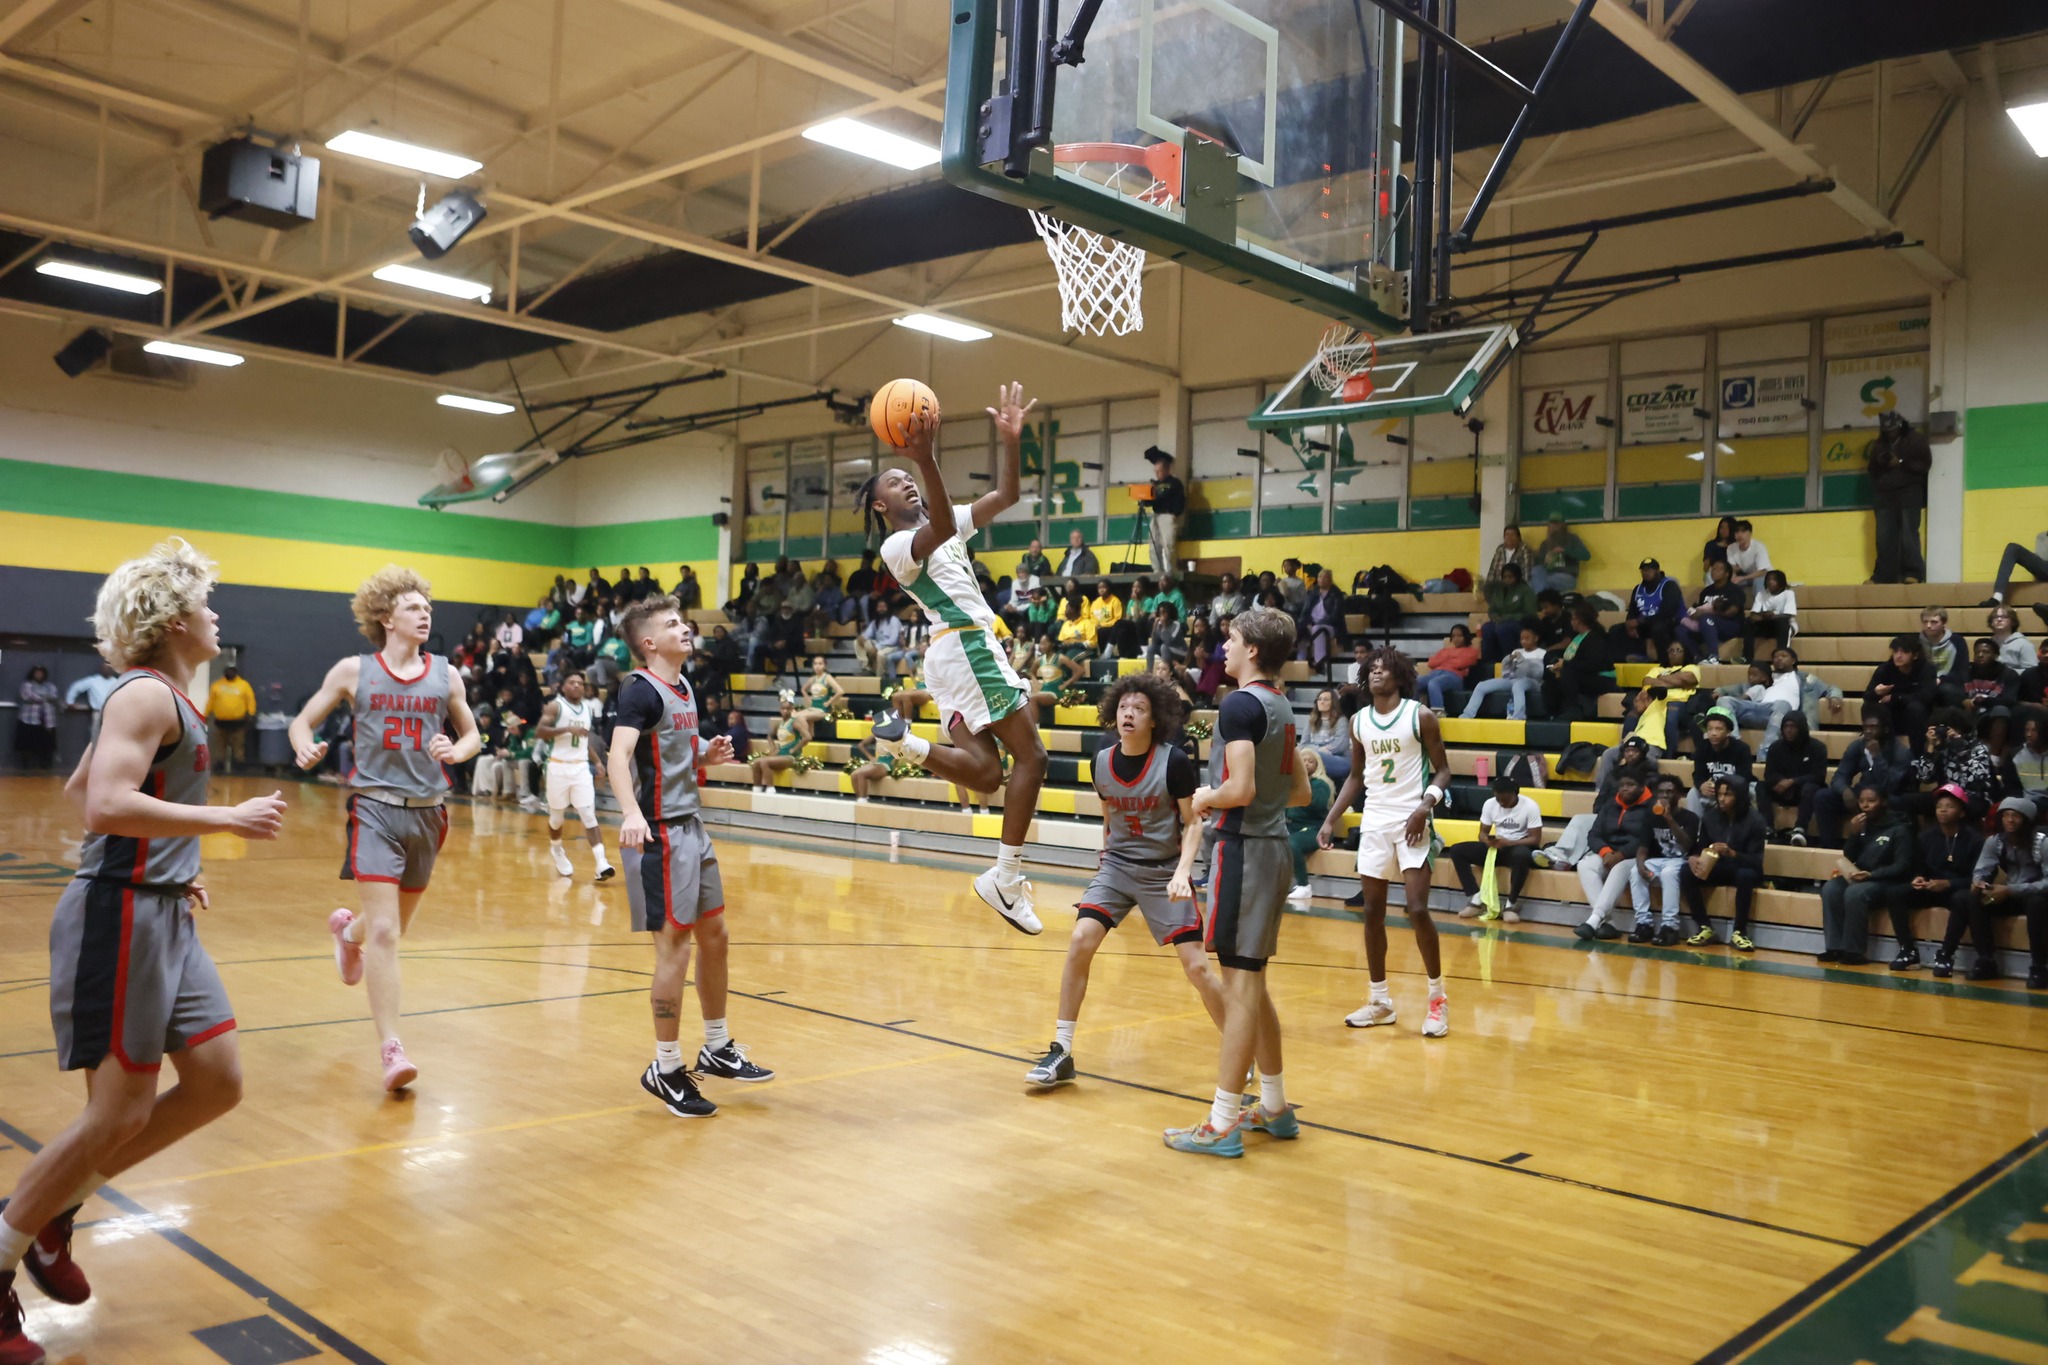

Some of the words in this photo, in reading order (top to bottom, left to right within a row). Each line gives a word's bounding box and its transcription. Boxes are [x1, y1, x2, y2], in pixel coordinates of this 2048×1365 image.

[1626, 387, 1699, 407] COZART
[1533, 389, 1596, 436] F&M
[1559, 421, 1586, 432] BANK
[370, 693, 438, 714] SPARTANS
[383, 716, 423, 751] 24
[1279, 723, 1295, 775] 11
[1371, 738, 1402, 755] CAVS
[1381, 758, 1397, 784] 2
[1124, 815, 1143, 837] 3
